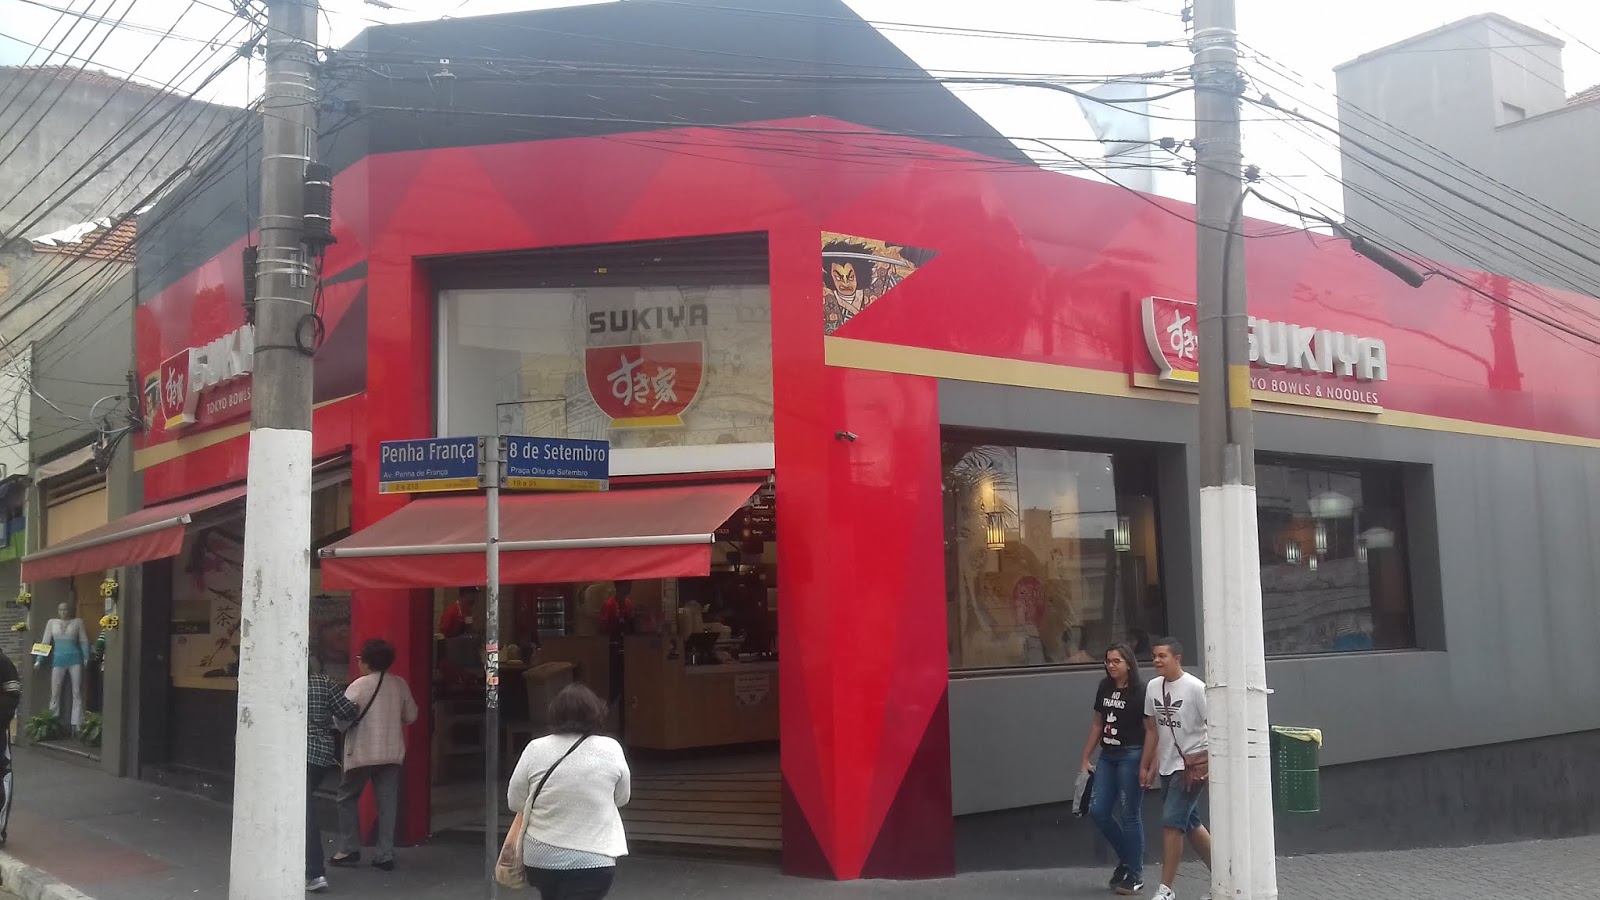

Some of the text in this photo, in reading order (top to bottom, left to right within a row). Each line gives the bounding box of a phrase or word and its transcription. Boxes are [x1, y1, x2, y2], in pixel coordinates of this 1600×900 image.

[589, 303, 708, 334] SUKIYA
[1167, 309, 1198, 359] すき
[606, 353, 678, 411] すき家
[1271, 379, 1311, 396] BOWLS
[1315, 385, 1323, 397] &
[1326, 387, 1379, 404] NOODLES
[206, 387, 251, 415] TOKYO BOWLS
[382, 442, 475, 464] Penha França
[509, 441, 606, 462] 8 de Setembro
[395, 469, 415, 477] Penha
[416, 469, 424, 477] de
[426, 468, 448, 477] França
[510, 466, 530, 475] Praça
[547, 467, 555, 475] de
[557, 468, 588, 477] Setembro
[1103, 697, 1126, 709] THANKS
[1111, 691, 1121, 700] NO
[1158, 717, 1182, 729] adidas
